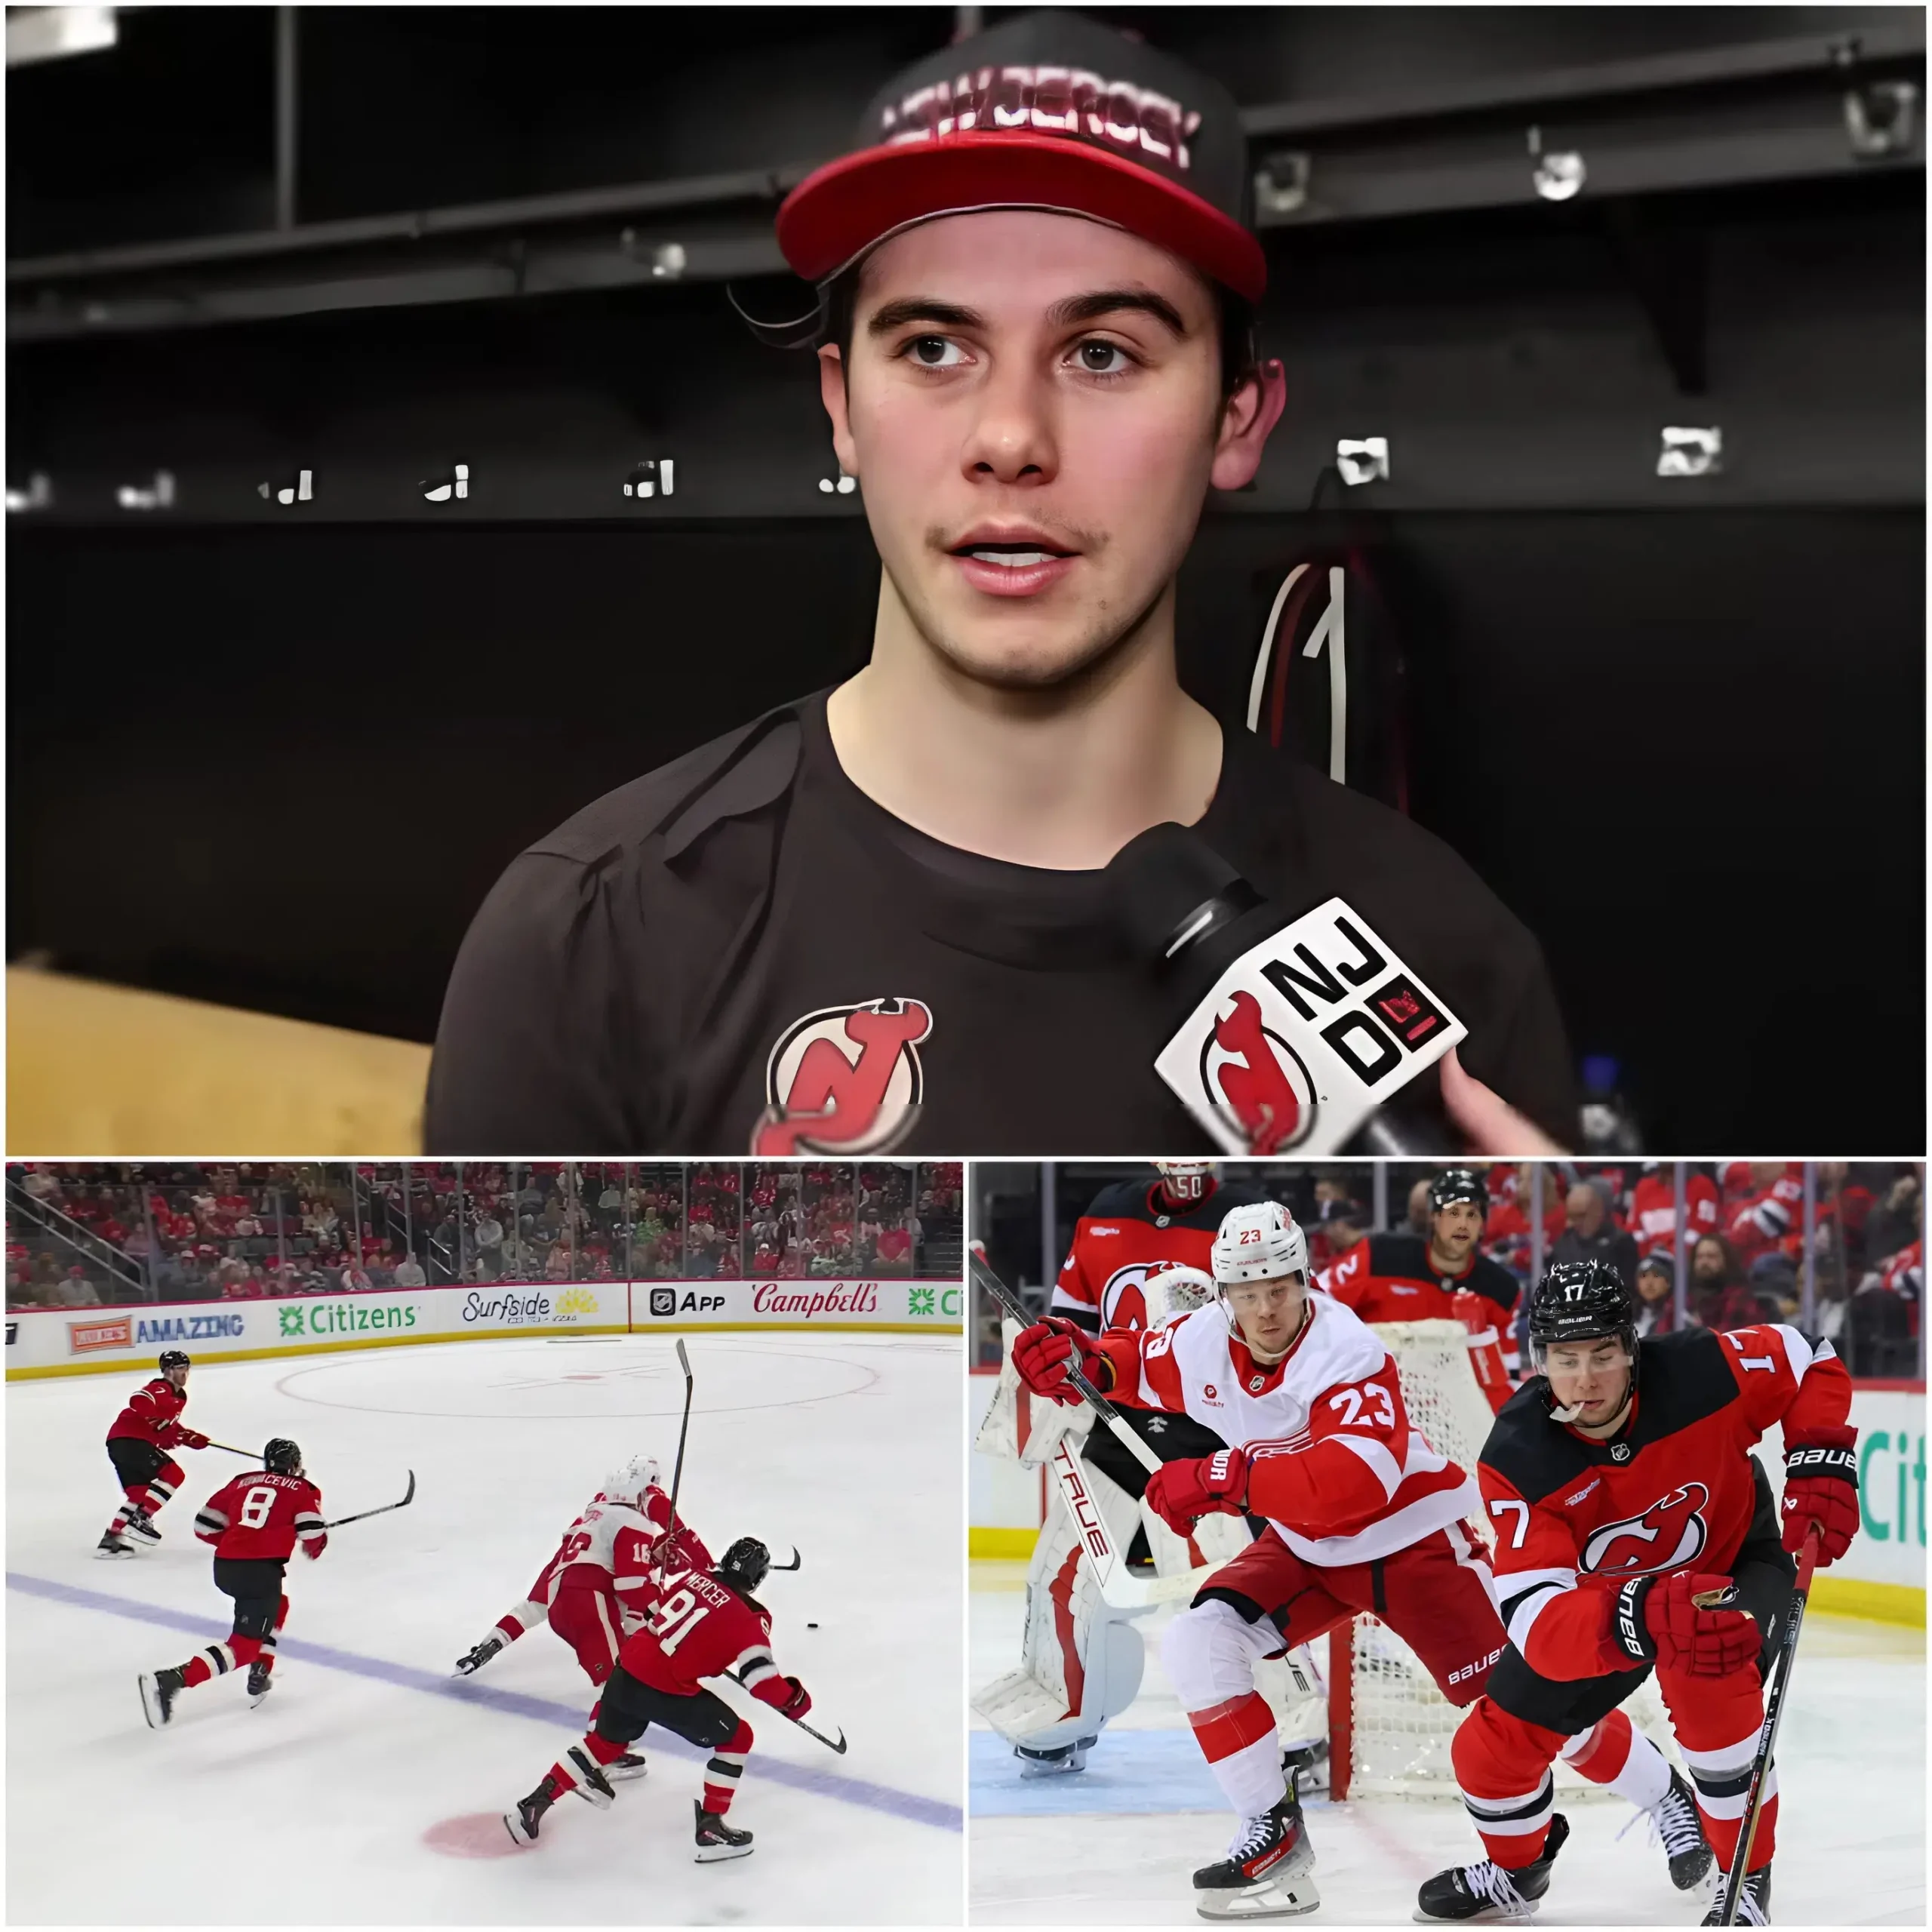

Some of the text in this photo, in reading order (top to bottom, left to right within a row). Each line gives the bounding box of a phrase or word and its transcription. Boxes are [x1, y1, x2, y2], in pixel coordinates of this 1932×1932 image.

[1259, 915, 1389, 1022] NJ
[1176, 1175, 1202, 1198] 50
[1239, 1229, 1262, 1245] 23
[462, 1291, 550, 1322] Surfside
[1564, 1284, 1585, 1303] 17
[309, 1303, 416, 1334] Citizens
[1329, 1383, 1396, 1431] 23
[237, 1486, 278, 1530] 8
[1054, 1440, 1109, 1558] TRUE
[681, 1571, 731, 1609] MERCER
[646, 1588, 710, 1658] 91
